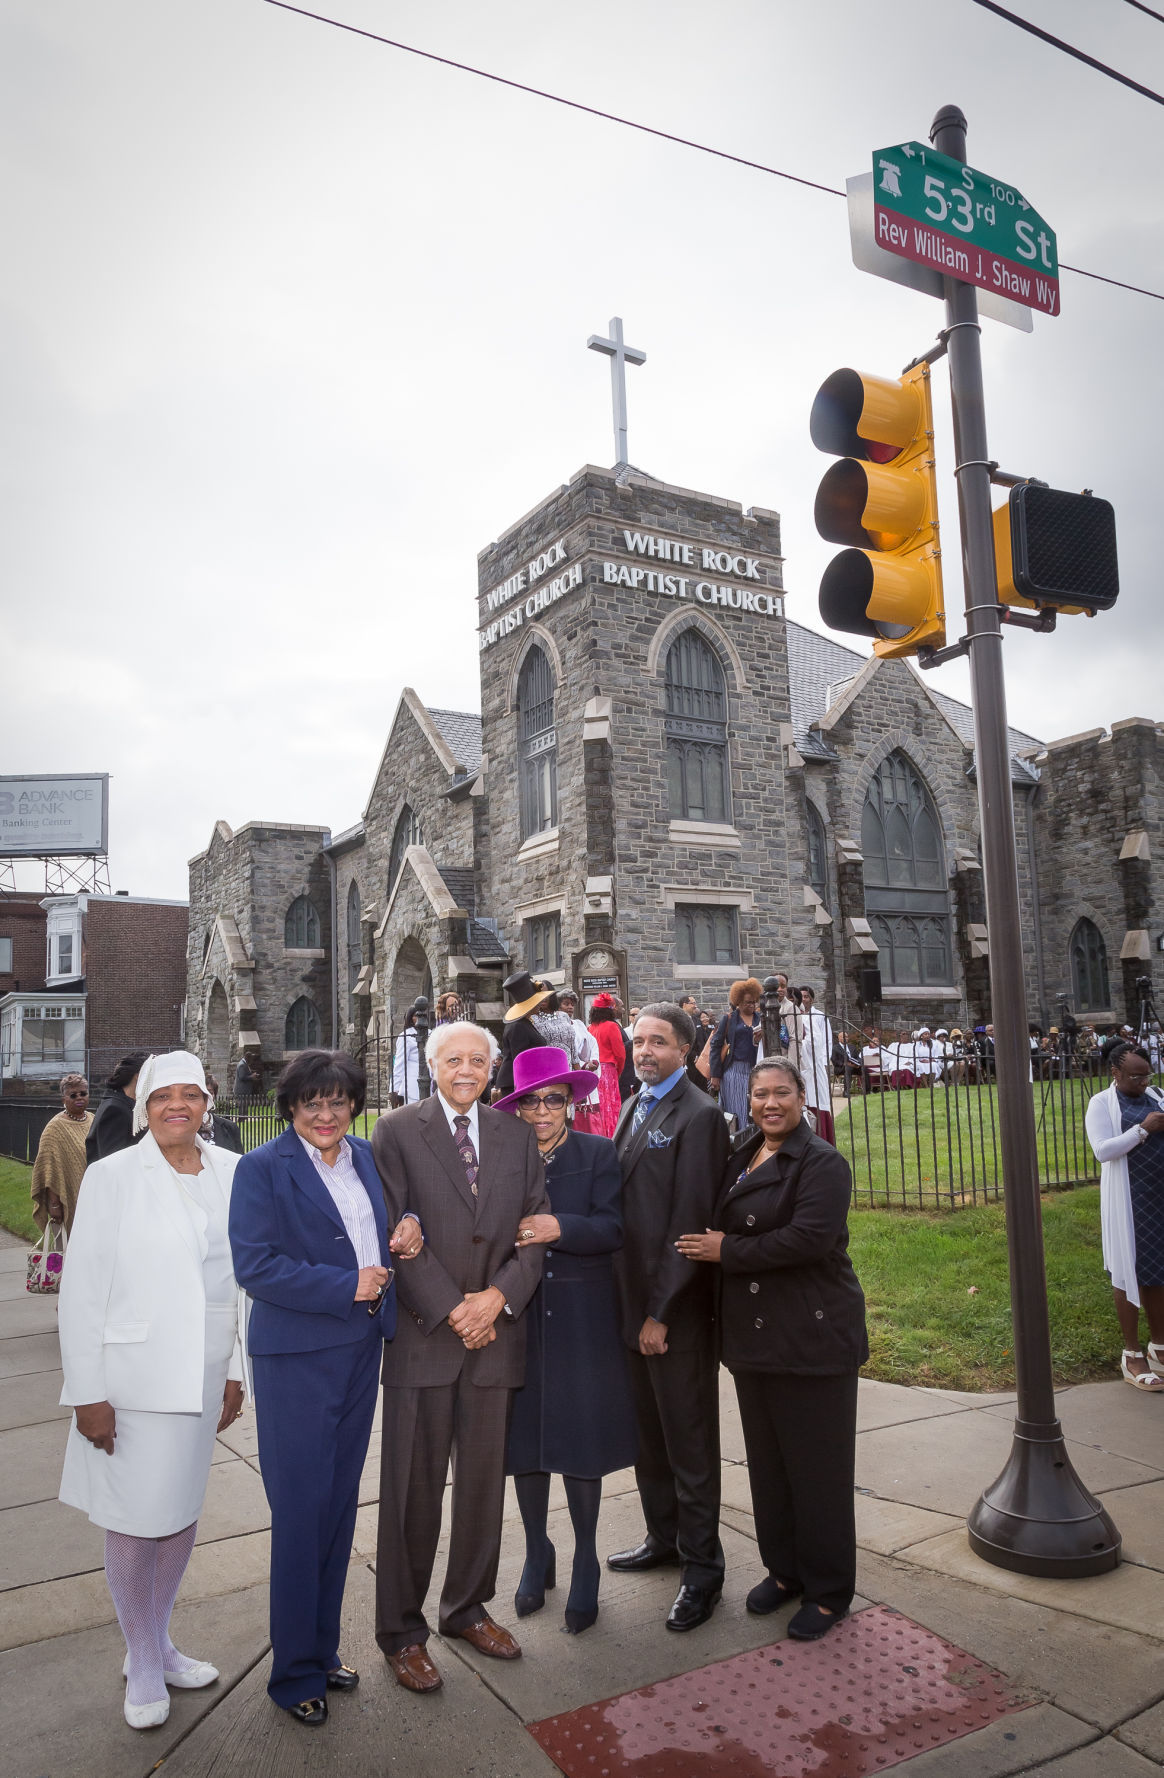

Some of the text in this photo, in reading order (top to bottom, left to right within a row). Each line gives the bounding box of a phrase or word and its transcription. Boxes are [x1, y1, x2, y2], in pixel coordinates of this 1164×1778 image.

[920, 151, 926, 166] 1
[961, 167, 975, 190] S
[989, 183, 1015, 206] 100
[923, 175, 1052, 268] 53rd St
[879, 212, 1056, 313] Rev William J. Shaw Wy
[623, 530, 760, 580] WHITE ROCK
[487, 538, 567, 611] WHITE ROCK
[603, 562, 783, 617] BAPTIST CHURCH
[480, 563, 583, 650] BAPTIST CHURCH
[18, 789, 94, 802] ADVANCE
[18, 803, 65, 815] BANK
[2, 818, 73, 829] Banking Center
